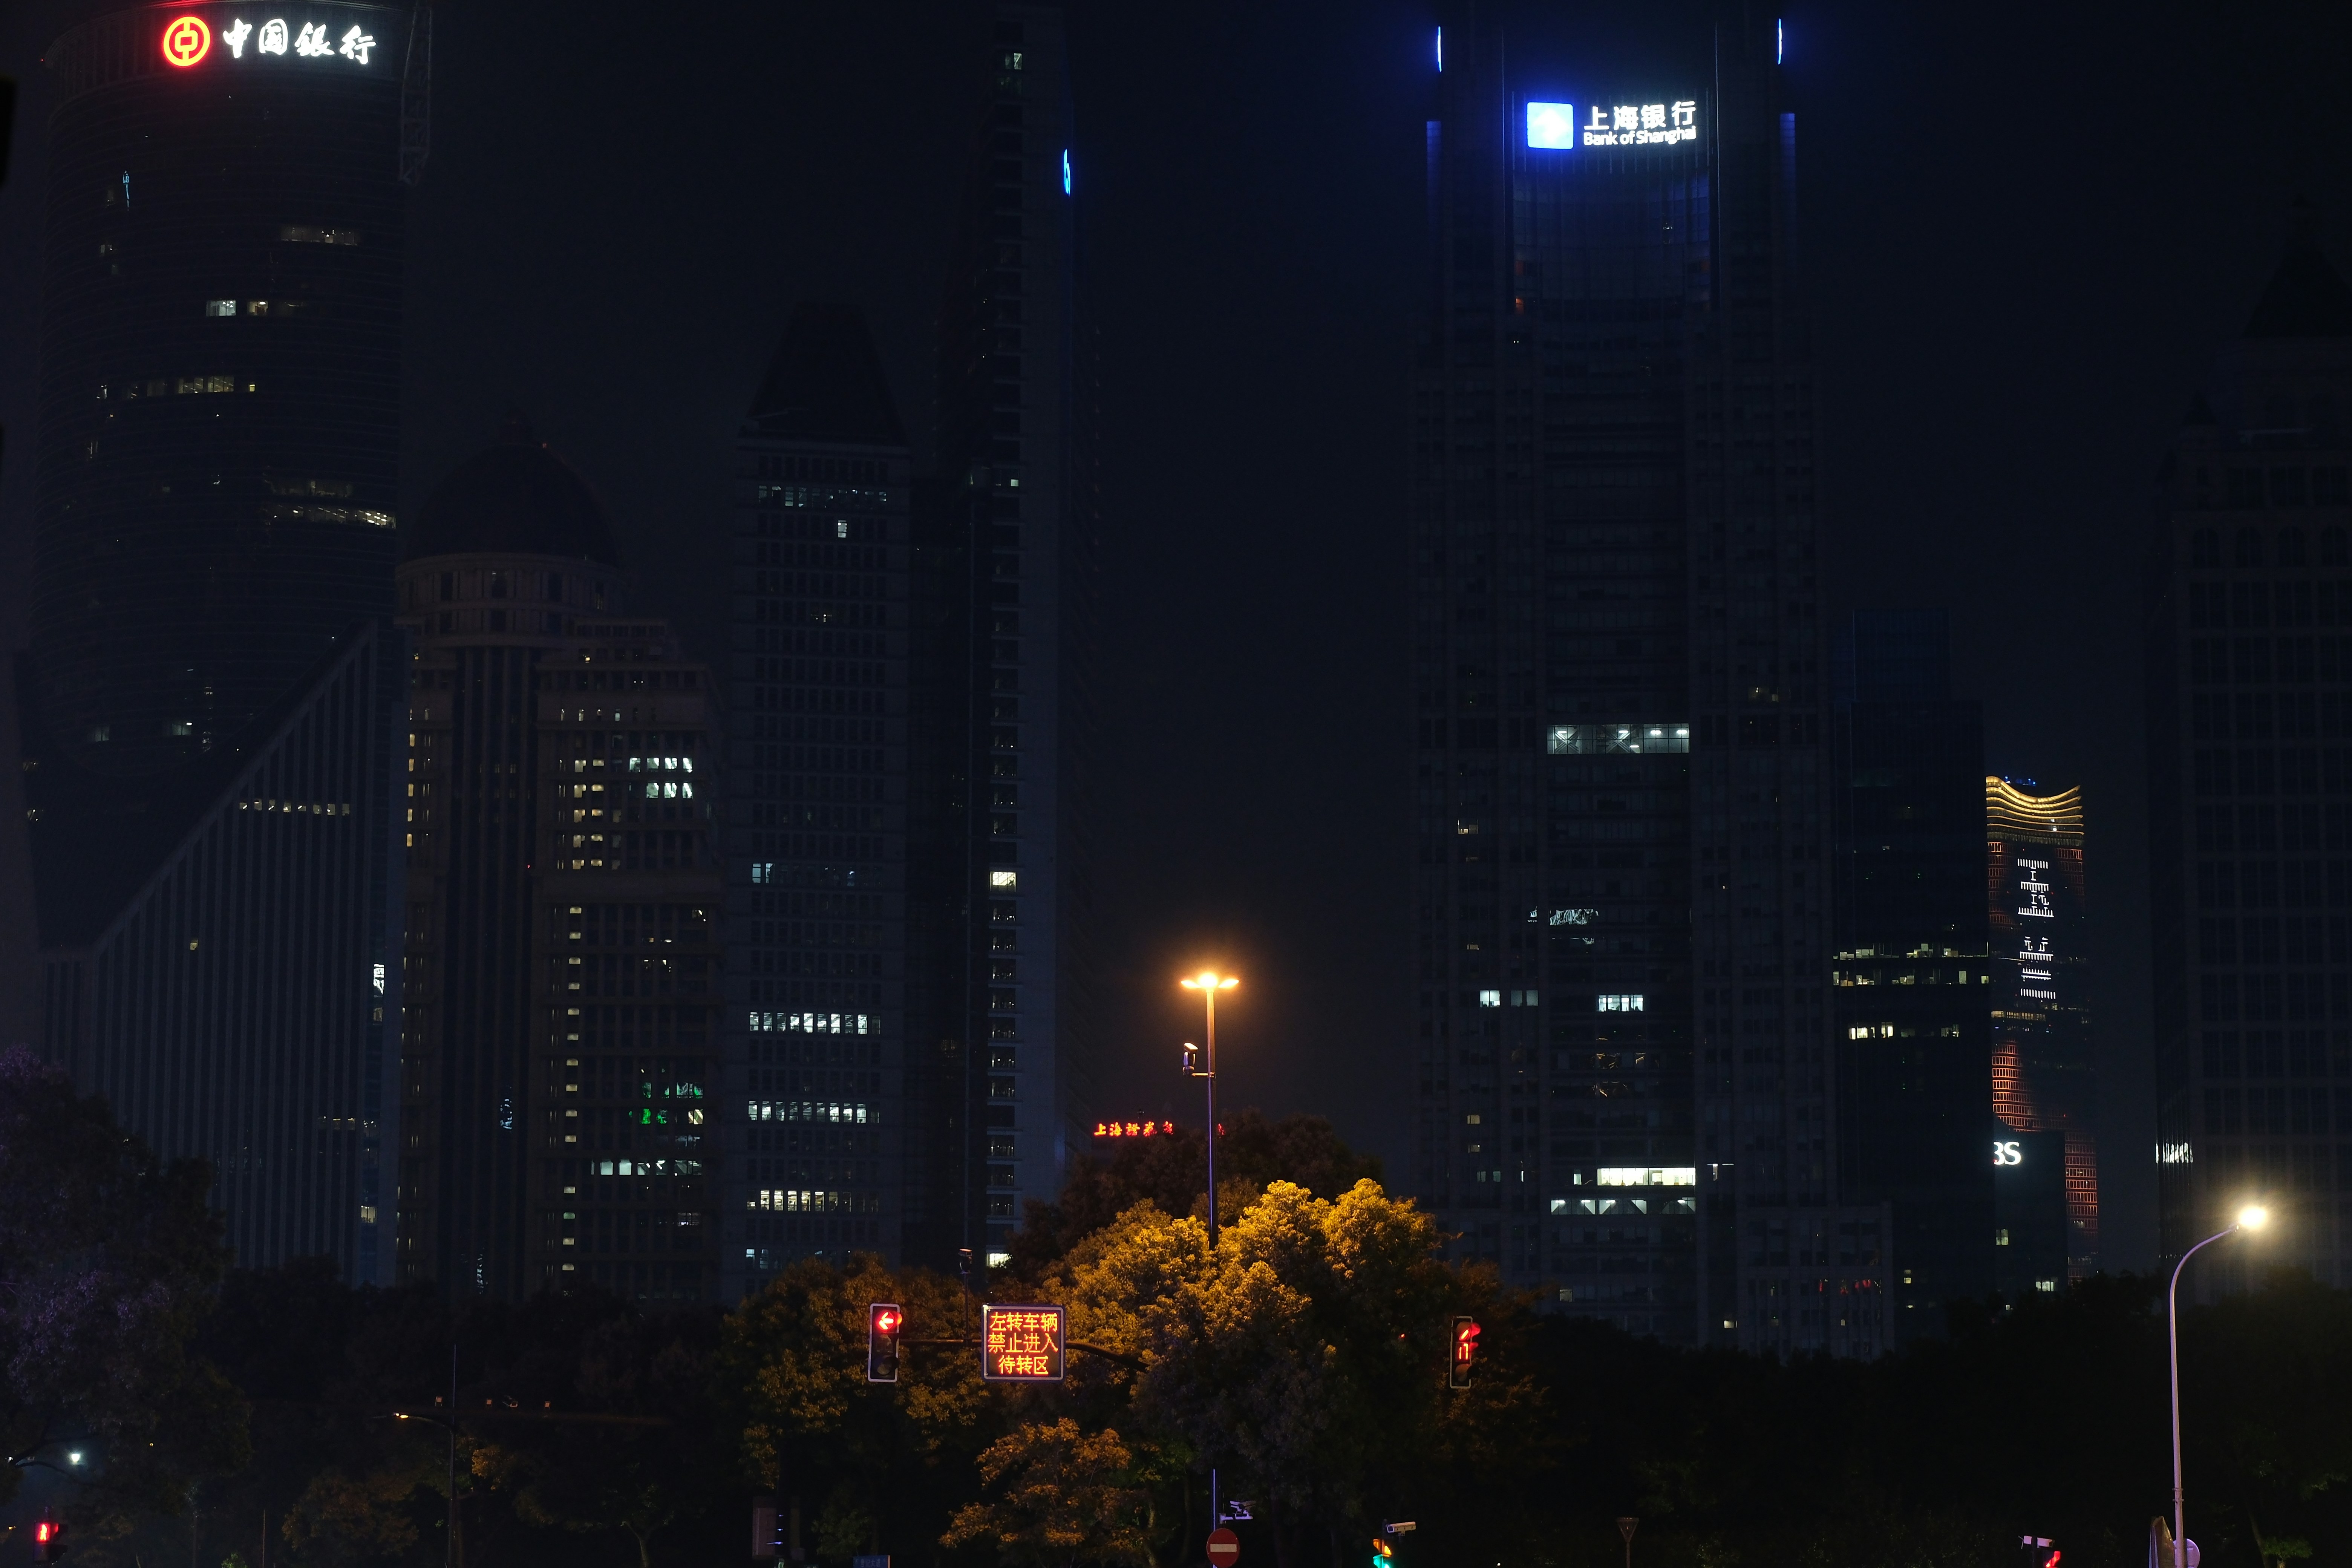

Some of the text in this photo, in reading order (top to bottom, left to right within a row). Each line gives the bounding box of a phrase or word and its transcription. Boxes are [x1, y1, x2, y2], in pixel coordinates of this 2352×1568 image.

[1584, 101, 1696, 130] 上海银行
[1584, 126, 1696, 145] Bank of Shanghai
[990, 1312, 1058, 1332] 左转车辆
[988, 1332, 1058, 1354] 禁止进入
[998, 1355, 1049, 1375] 待转区
